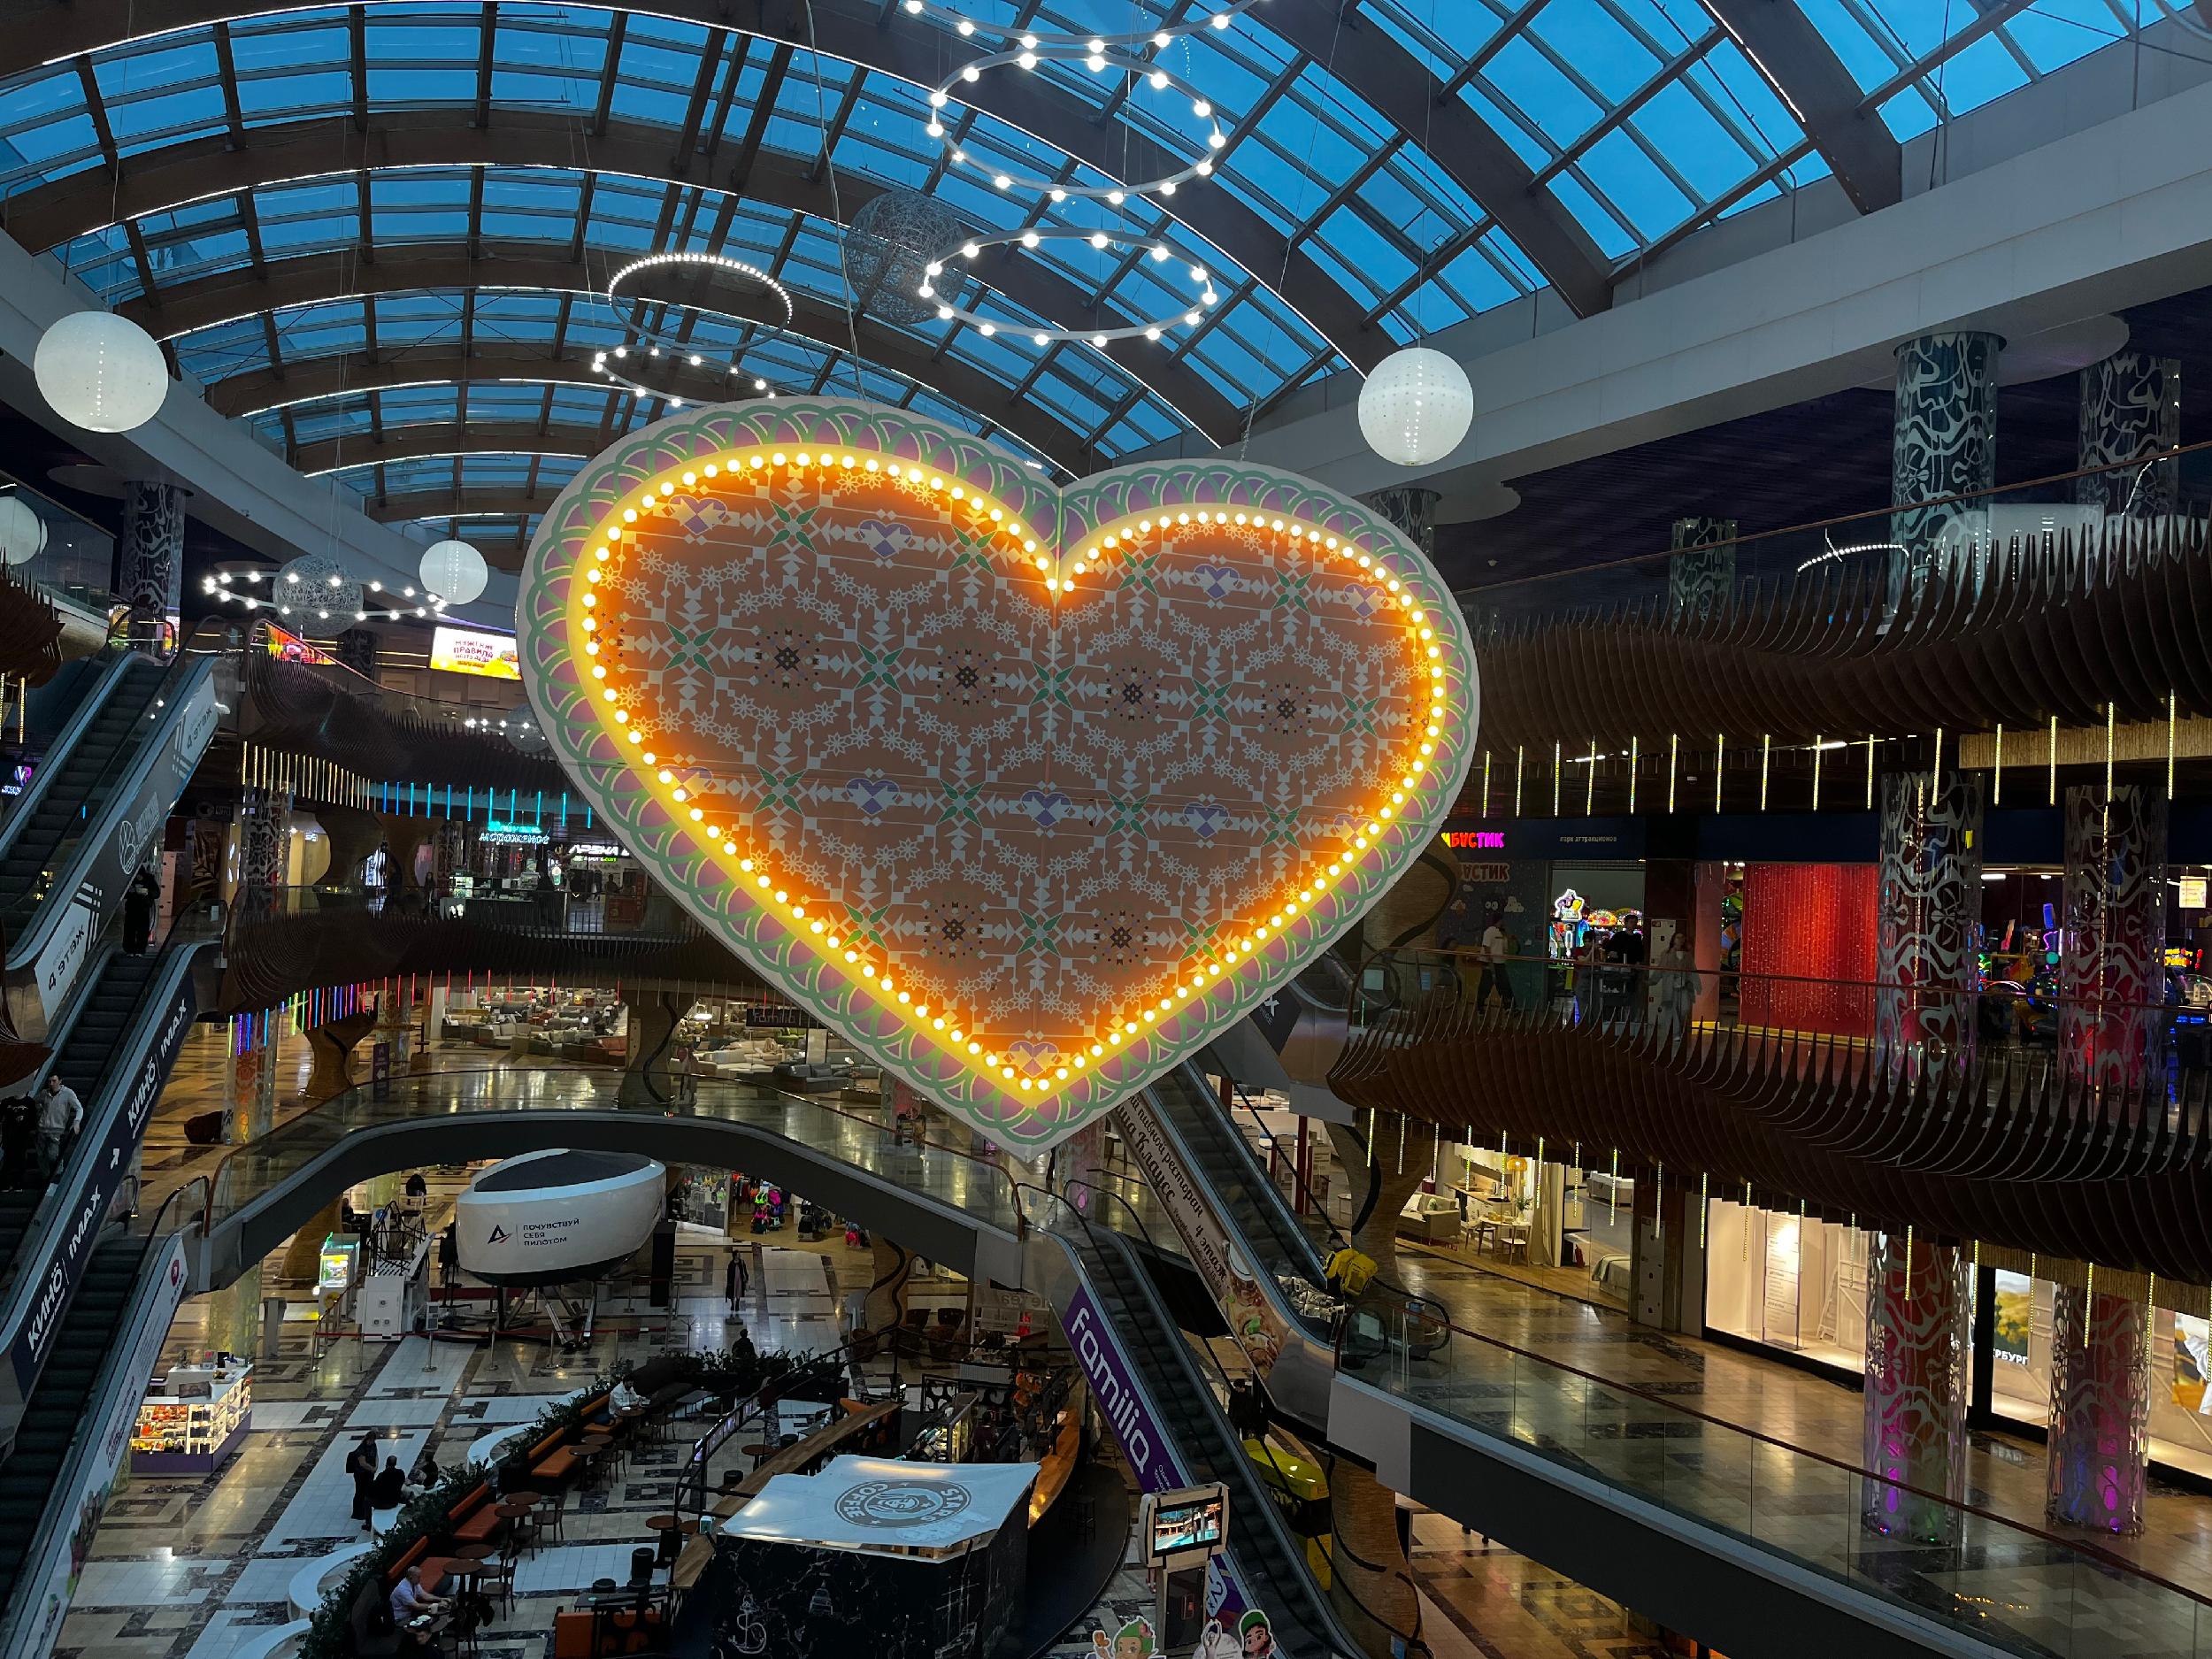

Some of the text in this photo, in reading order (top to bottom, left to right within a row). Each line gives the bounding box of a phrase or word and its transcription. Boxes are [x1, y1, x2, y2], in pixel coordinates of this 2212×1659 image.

[1461, 864, 1509, 880] АСТИК
[160, 998, 187, 1059] IMAX
[1162, 1151, 1203, 1218] ресторан
[69, 1184, 101, 1261] IMAX
[523, 1217, 580, 1231] ПОЧУВСТВУЙ
[524, 1237, 567, 1246] ПИЛОТОМ
[1071, 1307, 1149, 1475] familia
[843, 1483, 964, 1522] STARS COFFEE
